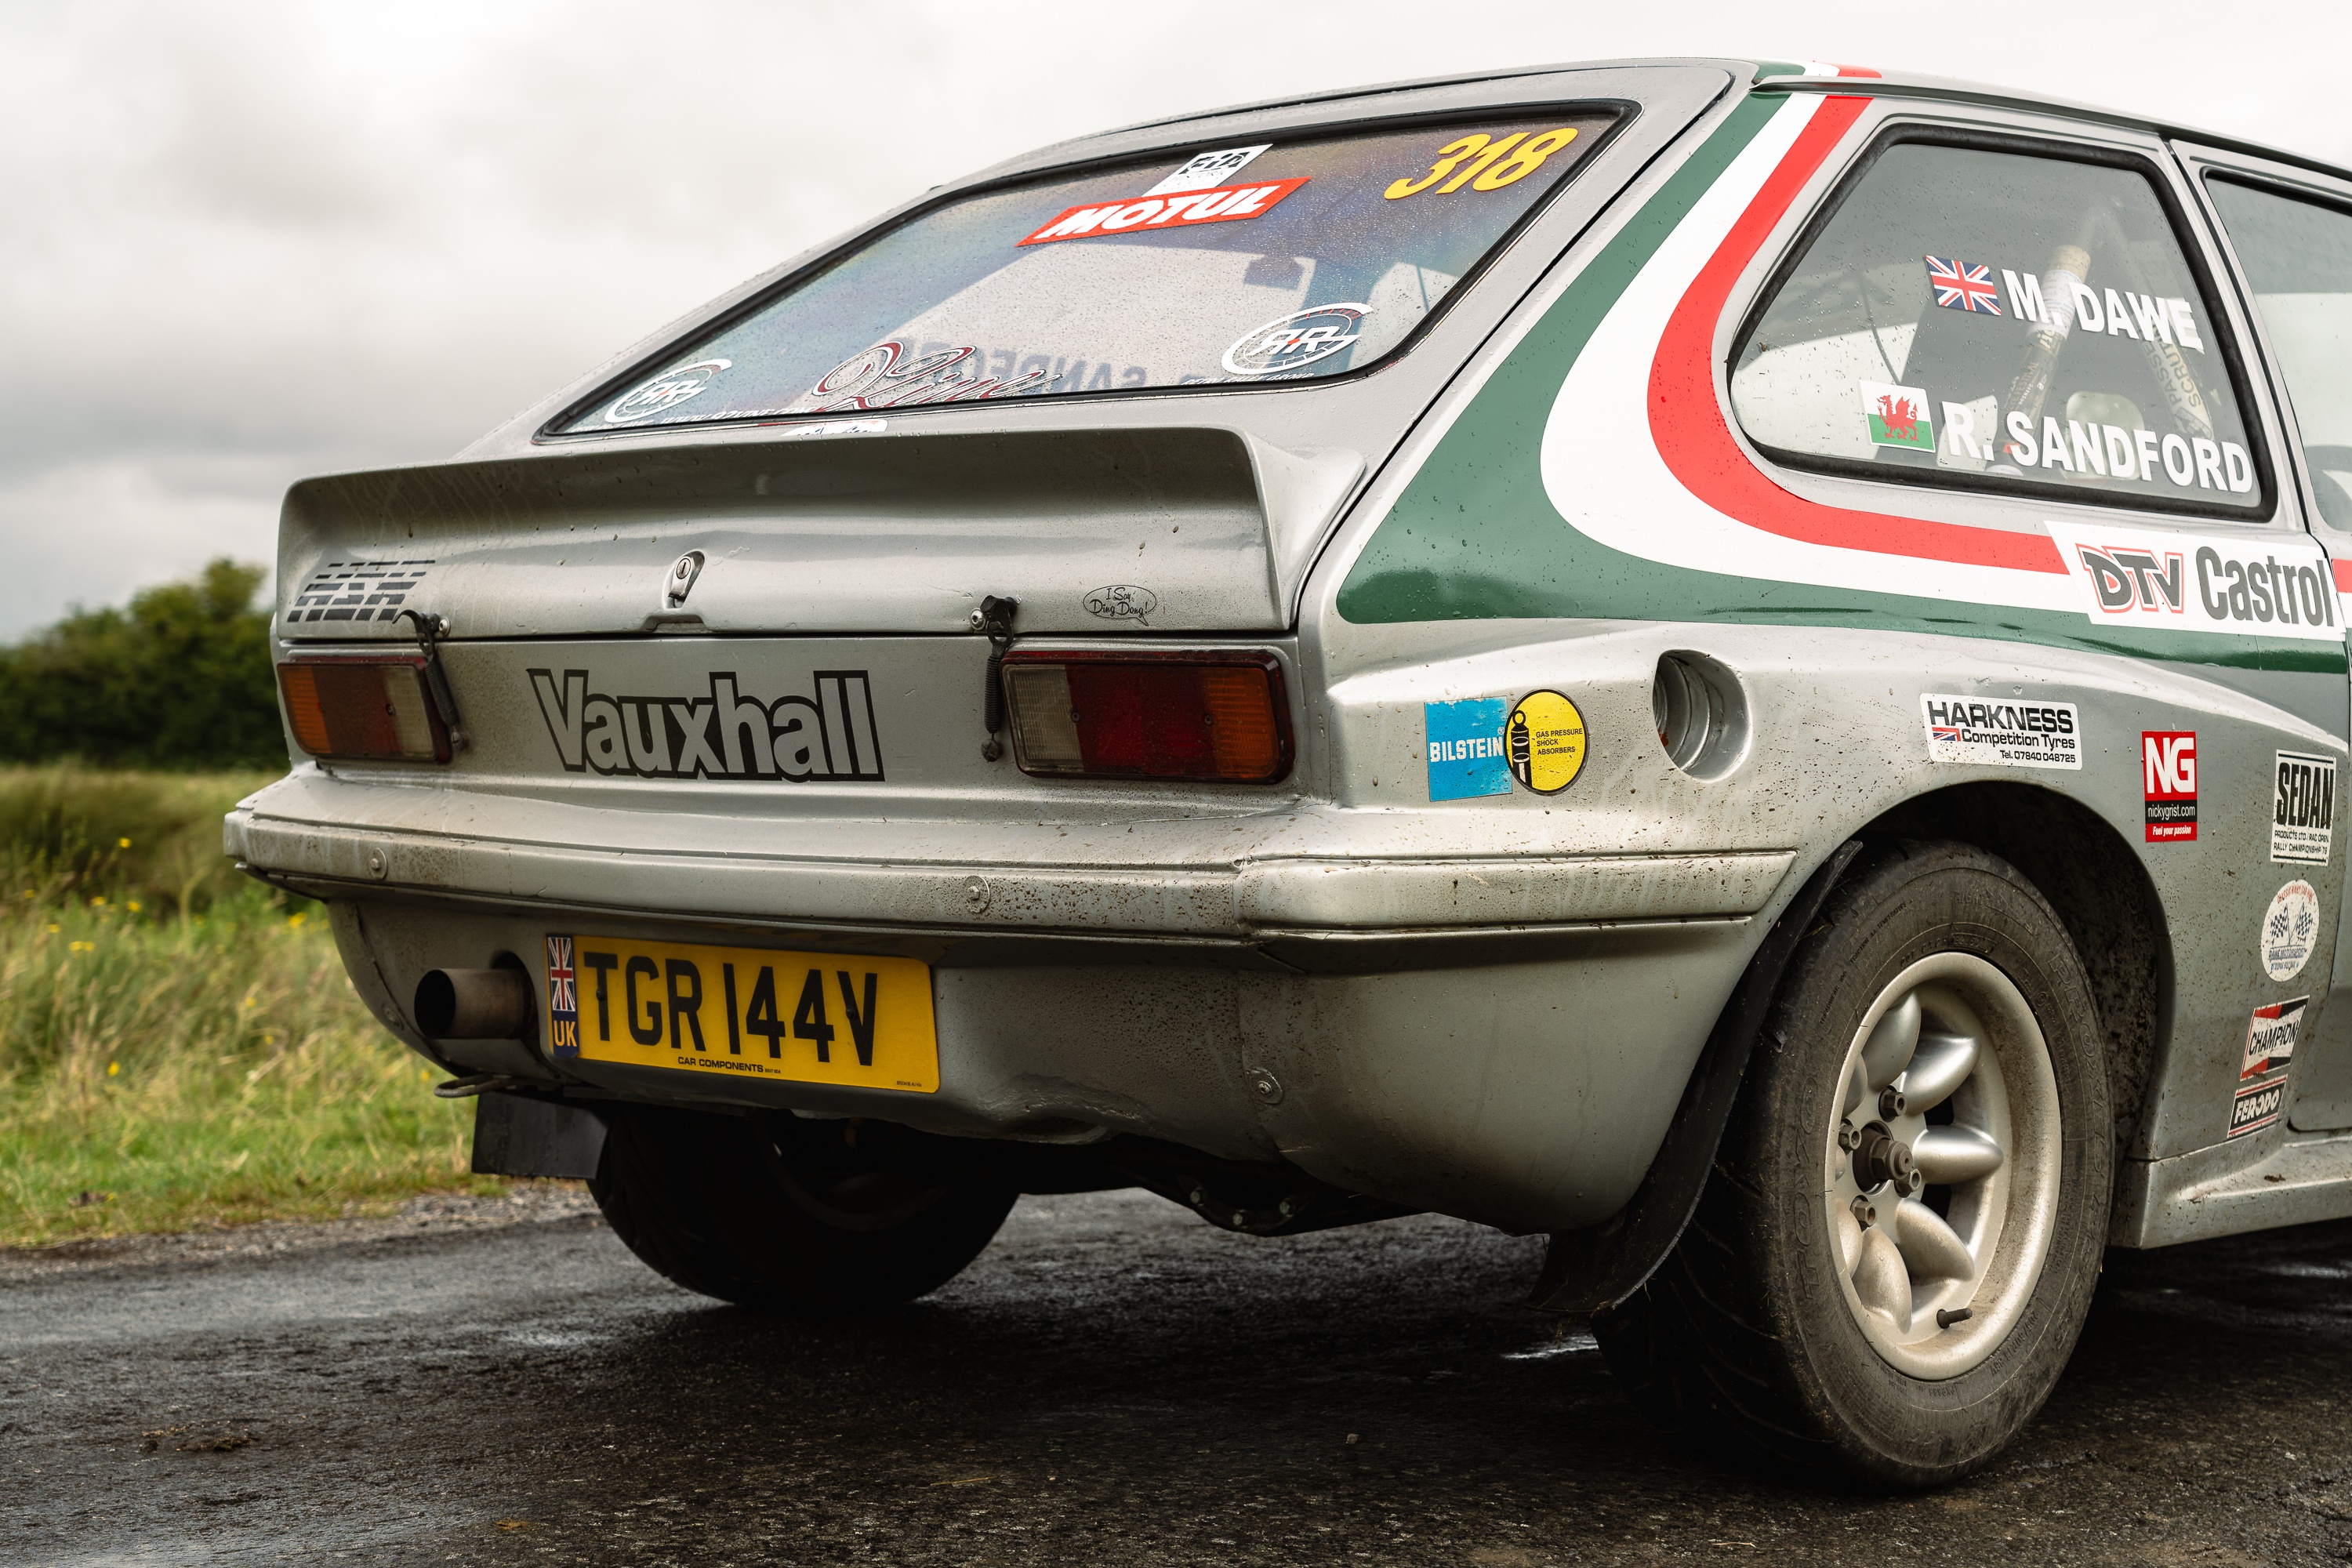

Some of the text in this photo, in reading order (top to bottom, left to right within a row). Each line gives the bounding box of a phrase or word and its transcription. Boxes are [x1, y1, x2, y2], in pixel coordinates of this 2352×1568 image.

[1385, 127, 1577, 200] 318
[1033, 185, 1281, 239] MOTUL
[2002, 268, 2203, 352] M. DAWE
[1941, 401, 2252, 494] R. SANDFORD
[1106, 587, 1112, 600] I
[2078, 545, 2334, 626] DTV Castrol
[1089, 598, 1148, 618] Ding Dong!
[526, 668, 886, 782] Vauxhall
[1927, 700, 2074, 734] HARKNESS
[1550, 728, 1583, 738] PRESSURE
[1962, 728, 2075, 752] Competition Tyres
[1429, 736, 1504, 763] BILSTEIN
[1537, 746, 1576, 755] ABSORBERS
[2000, 750, 2076, 763] Tel. 07840 048725
[2145, 737, 2195, 793] NG
[2277, 762, 2334, 829] SEDAN
[2148, 804, 2195, 821] nickygrist.com
[2152, 825, 2192, 837] Fuel your passion
[2274, 829, 2298, 840] PRODUCTS
[2274, 842, 2288, 853] RALLY
[2288, 844, 2321, 855] CHAMPIONSHIP
[583, 951, 877, 1066] TGR 144V
[553, 1020, 577, 1048] UK
[2249, 1019, 2299, 1056] CHAMPION
[677, 1056, 696, 1066] CAR
[699, 1058, 764, 1073] COMPONENTS
[2234, 1089, 2281, 1124] FERODO
